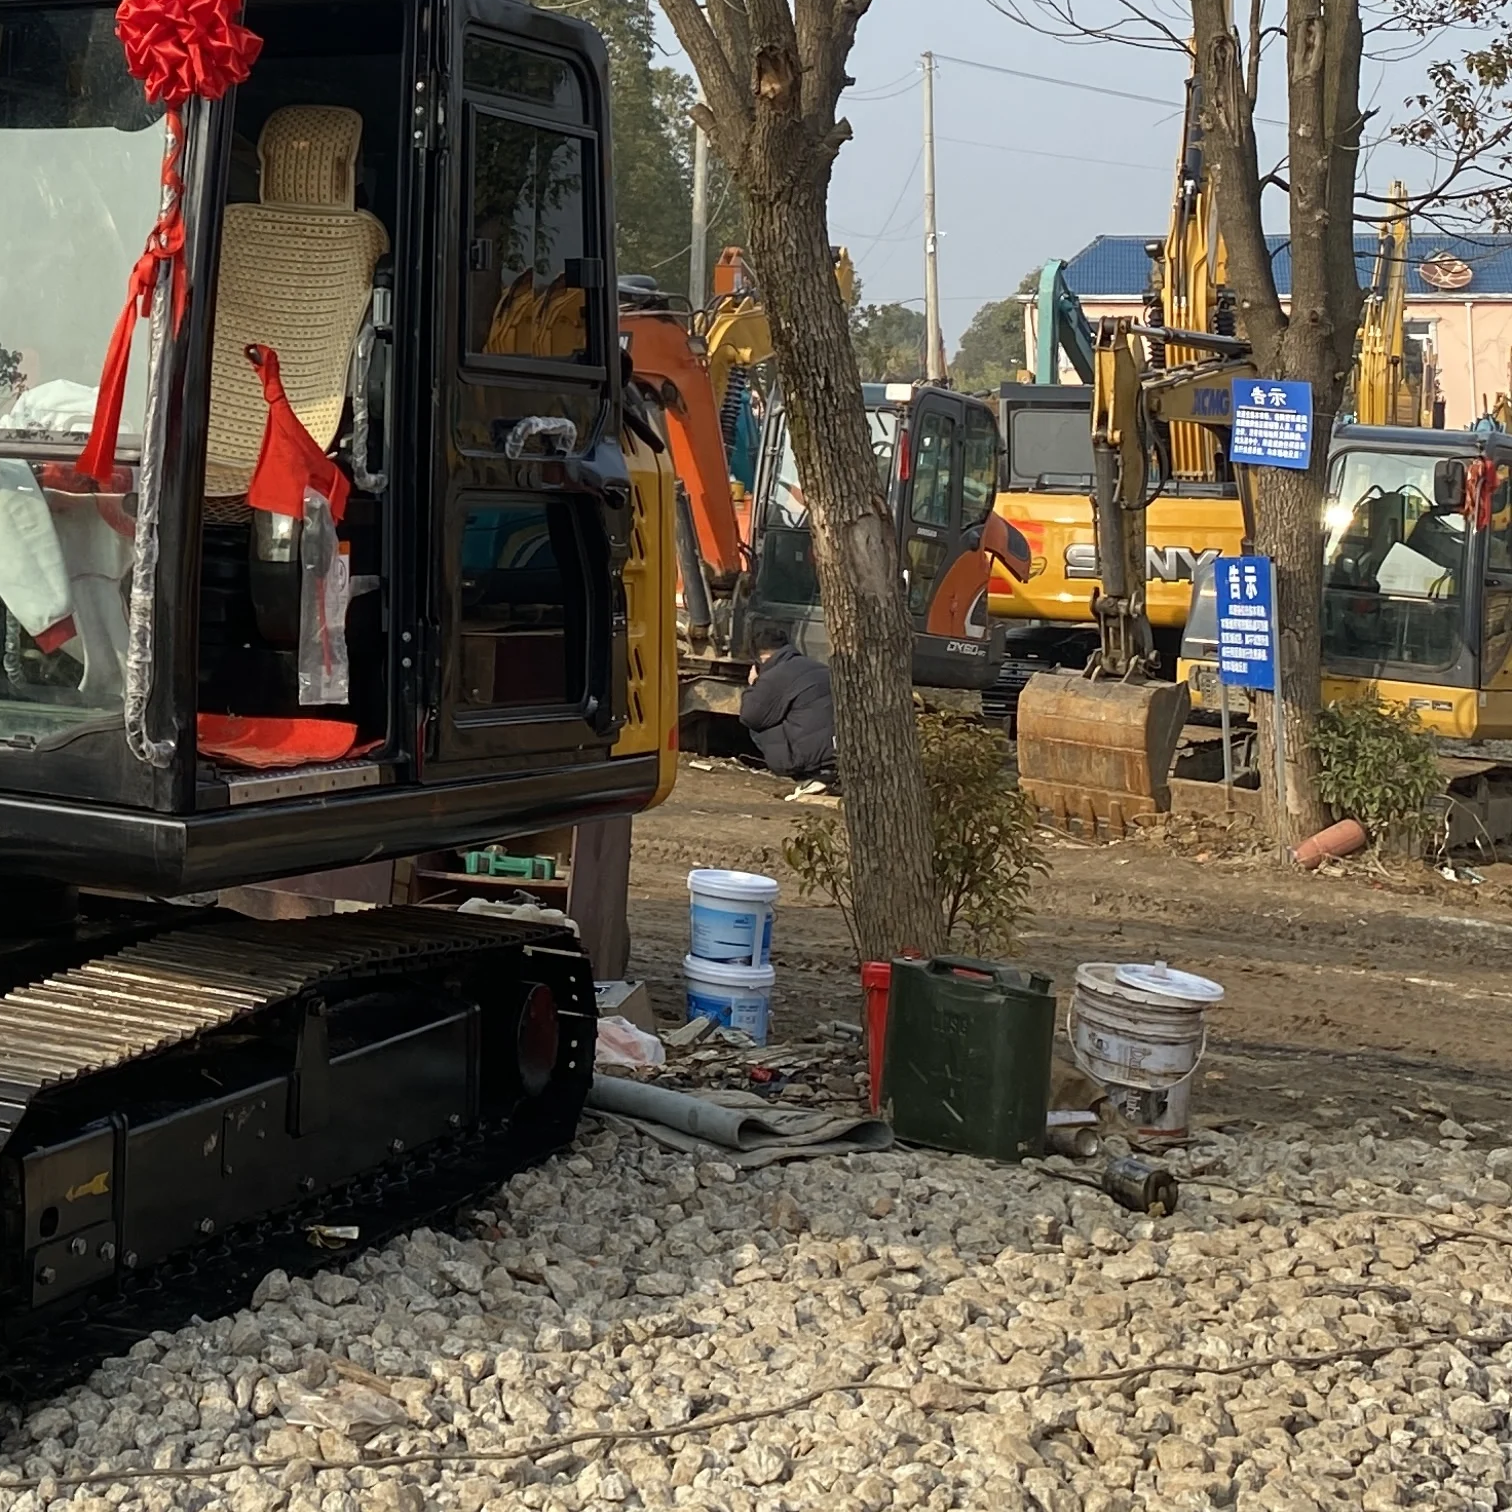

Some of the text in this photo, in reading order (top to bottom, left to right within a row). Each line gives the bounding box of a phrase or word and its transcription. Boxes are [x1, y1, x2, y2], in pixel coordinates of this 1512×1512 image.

[1250, 386, 1287, 407] 告示
[1064, 543, 1223, 584] SNY
[1228, 564, 1258, 600] 告示
